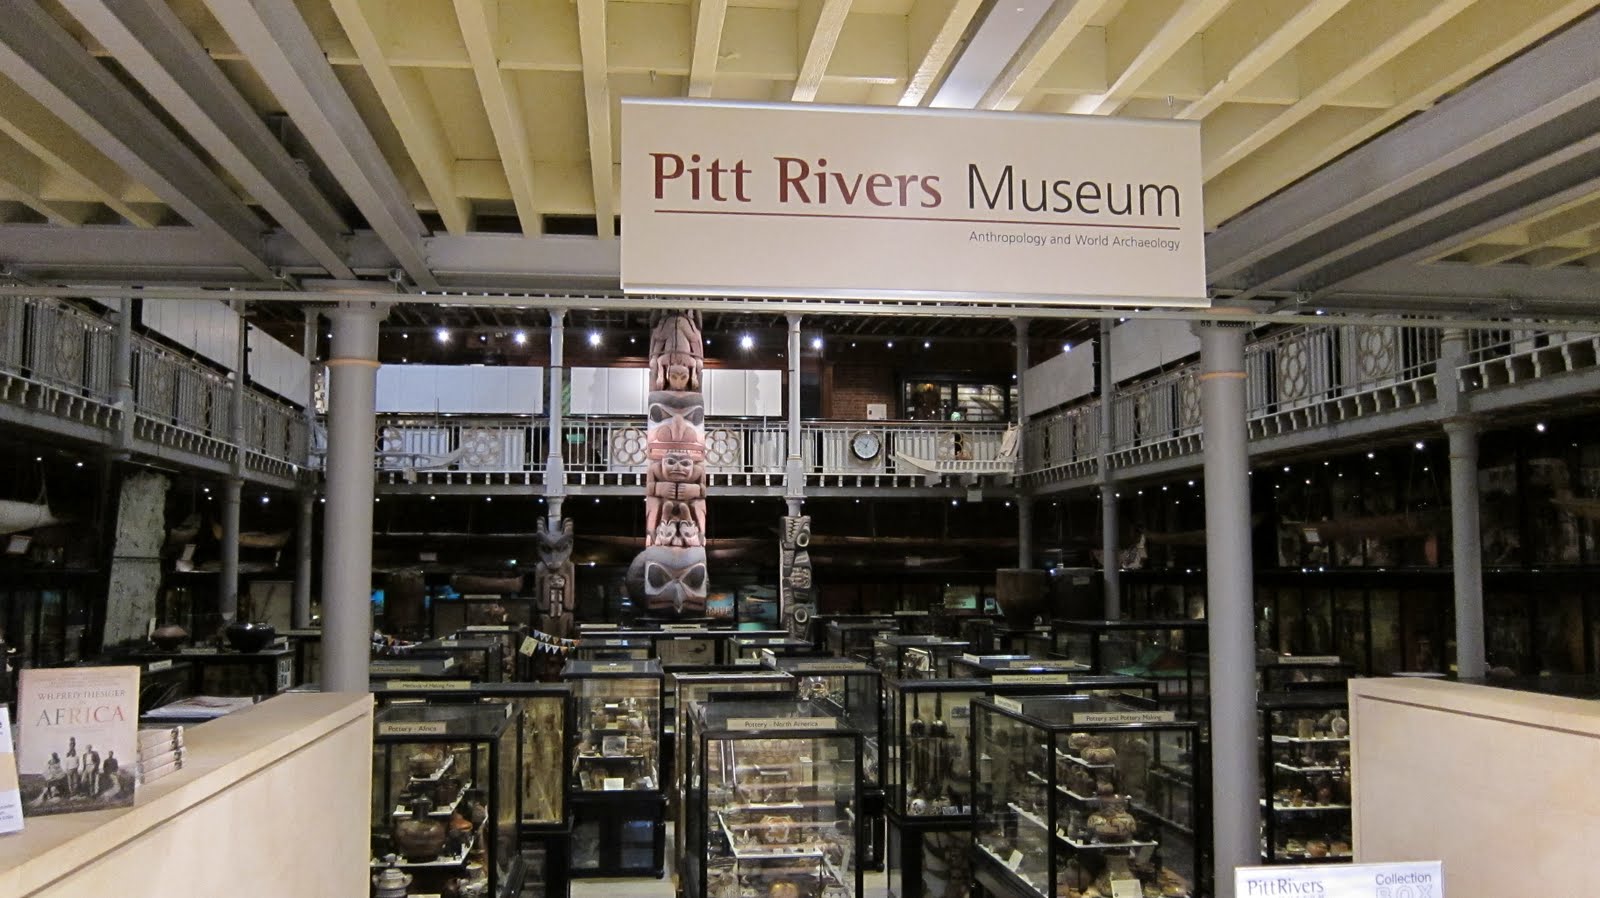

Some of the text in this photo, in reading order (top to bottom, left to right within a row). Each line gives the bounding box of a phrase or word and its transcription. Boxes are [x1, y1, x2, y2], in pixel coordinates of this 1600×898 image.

[649, 153, 1180, 217] Pitt Rivers Museum
[969, 231, 1180, 251] Anthropology and World Archaeology
[38, 691, 80, 700] WILFRED
[36, 705, 125, 727] AFRICA
[1120, 714, 1140, 722] Pottery
[1142, 714, 1162, 722] Making
[387, 725, 412, 733] Pottery
[744, 721, 768, 729] Pottery
[1375, 872, 1432, 886] Collection
